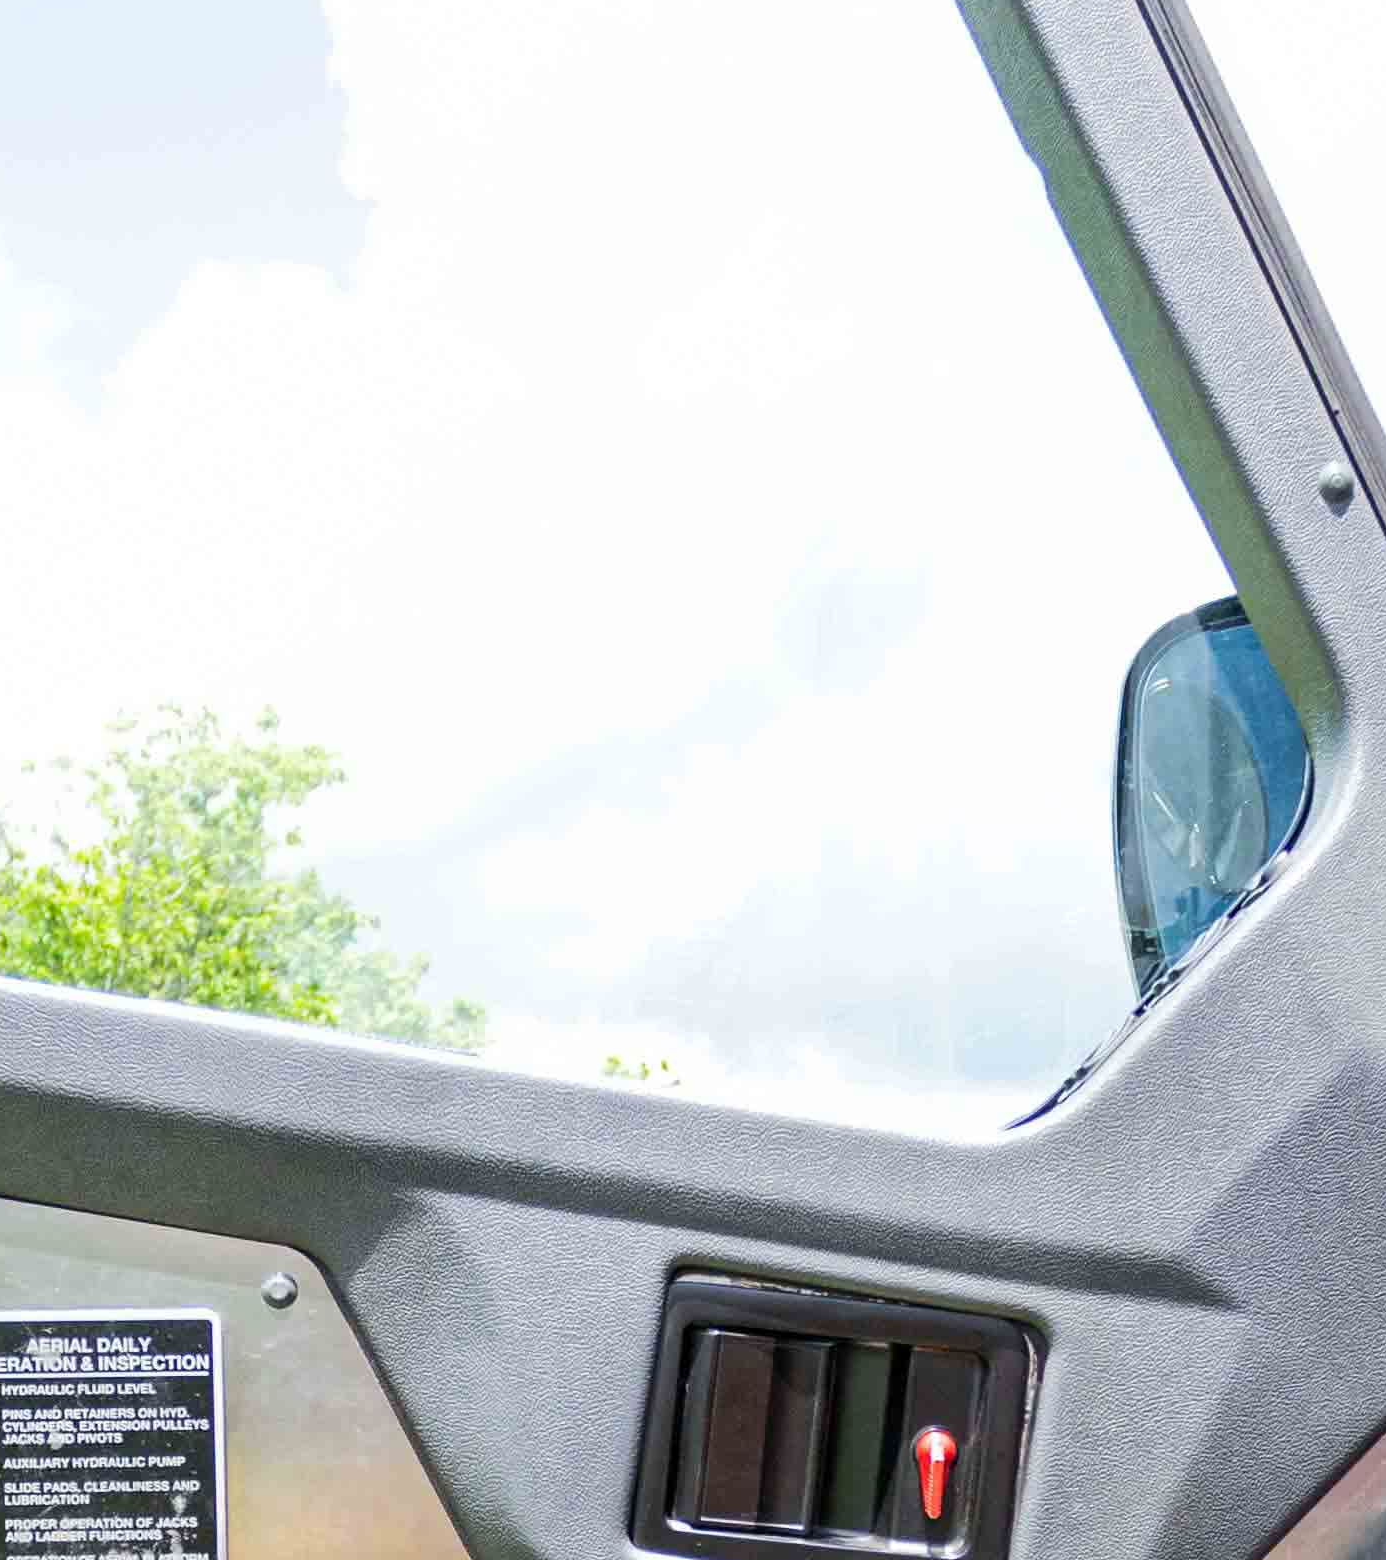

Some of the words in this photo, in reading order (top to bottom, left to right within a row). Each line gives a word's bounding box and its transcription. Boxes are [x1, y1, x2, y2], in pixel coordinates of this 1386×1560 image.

[26, 1337, 93, 1354] AERIAL
[97, 1336, 152, 1353] DAILY
[80, 1356, 93, 1371] &
[98, 1354, 210, 1371] INSPECTION
[1, 1384, 75, 1396] HYDRAULIC
[77, 1383, 114, 1395] FLUID
[117, 1382, 156, 1395] LEVEL
[1, 1408, 32, 1420] PINS
[34, 1408, 62, 1420] AND
[64, 1407, 135, 1420] RETAINERS
[137, 1407, 158, 1419] ON
[160, 1406, 190, 1419] HYD.
[79, 1420, 150, 1432] EXTENSION
[153, 1419, 210, 1431] PULLEYS
[1, 1433, 45, 1445] JACKS
[77, 1432, 123, 1445] PIVOTS
[3, 1457, 70, 1469] AUXILIARY
[72, 1456, 146, 1468] HYDRAULIC
[148, 1456, 187, 1468] PUMP
[4, 1482, 41, 1494] SLIDE
[83, 1480, 170, 1493] CLEANLINESS
[172, 1480, 201, 1492] AND
[4, 1494, 90, 1507] LUBRICATION
[4, 1519, 58, 1531] PROPER
[59, 1518, 132, 1531] OPERATION
[135, 1517, 153, 1529] OF
[155, 1516, 198, 1529] JACKS
[4, 1531, 33, 1543] AND
[89, 1529, 163, 1541] FUNCTIONS
